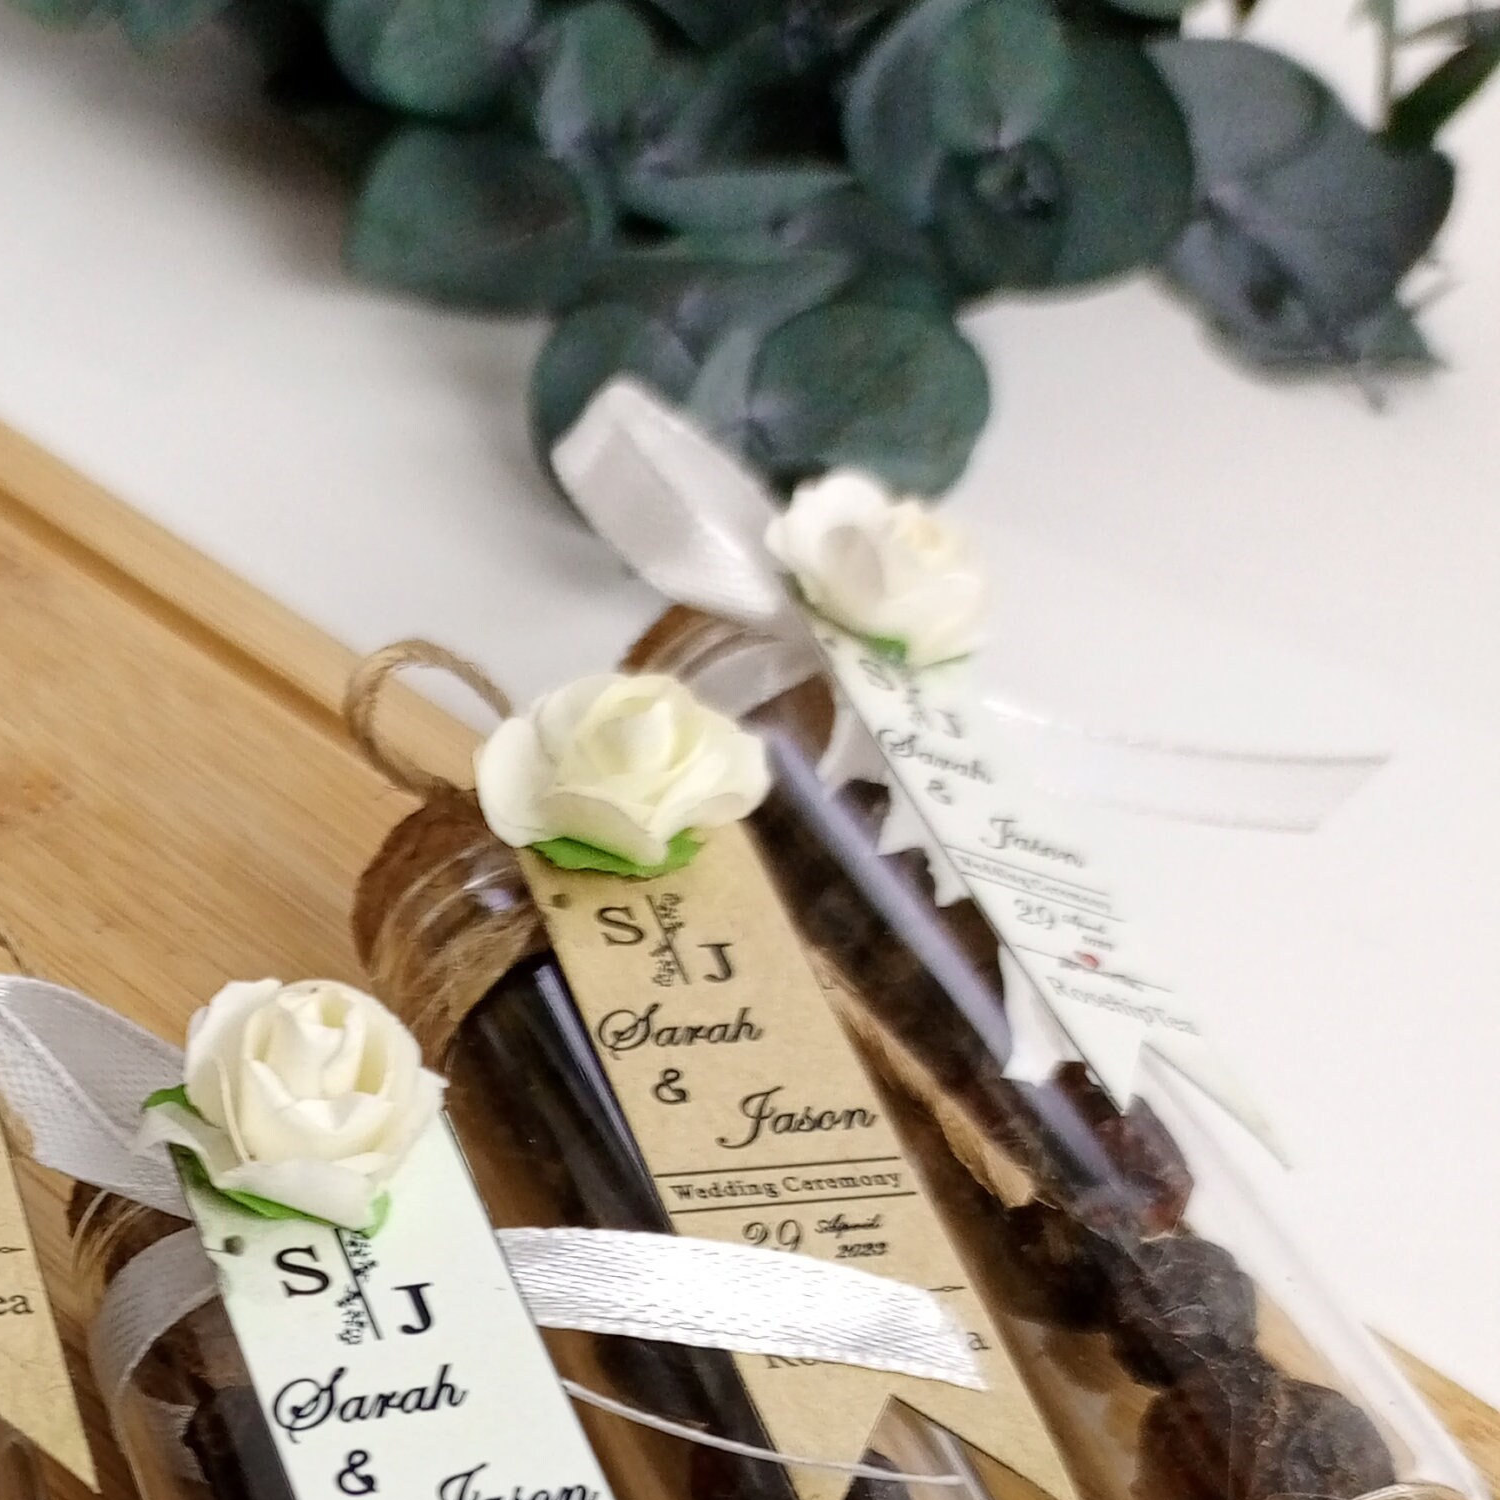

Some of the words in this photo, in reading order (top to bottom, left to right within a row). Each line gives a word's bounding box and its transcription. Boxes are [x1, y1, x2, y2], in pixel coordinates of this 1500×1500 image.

[595, 907, 645, 946] S
[697, 944, 734, 983] J
[598, 1003, 763, 1060] Sarah
[654, 1068, 691, 1105] &
[715, 1087, 877, 1149] Jason
[668, 1181, 778, 1201] Wedding
[783, 1171, 902, 1192] Ceremony
[275, 1245, 331, 1298] S
[391, 1282, 435, 1335] J
[273, 1363, 469, 1444] Sarah
[336, 1449, 380, 1496] &
